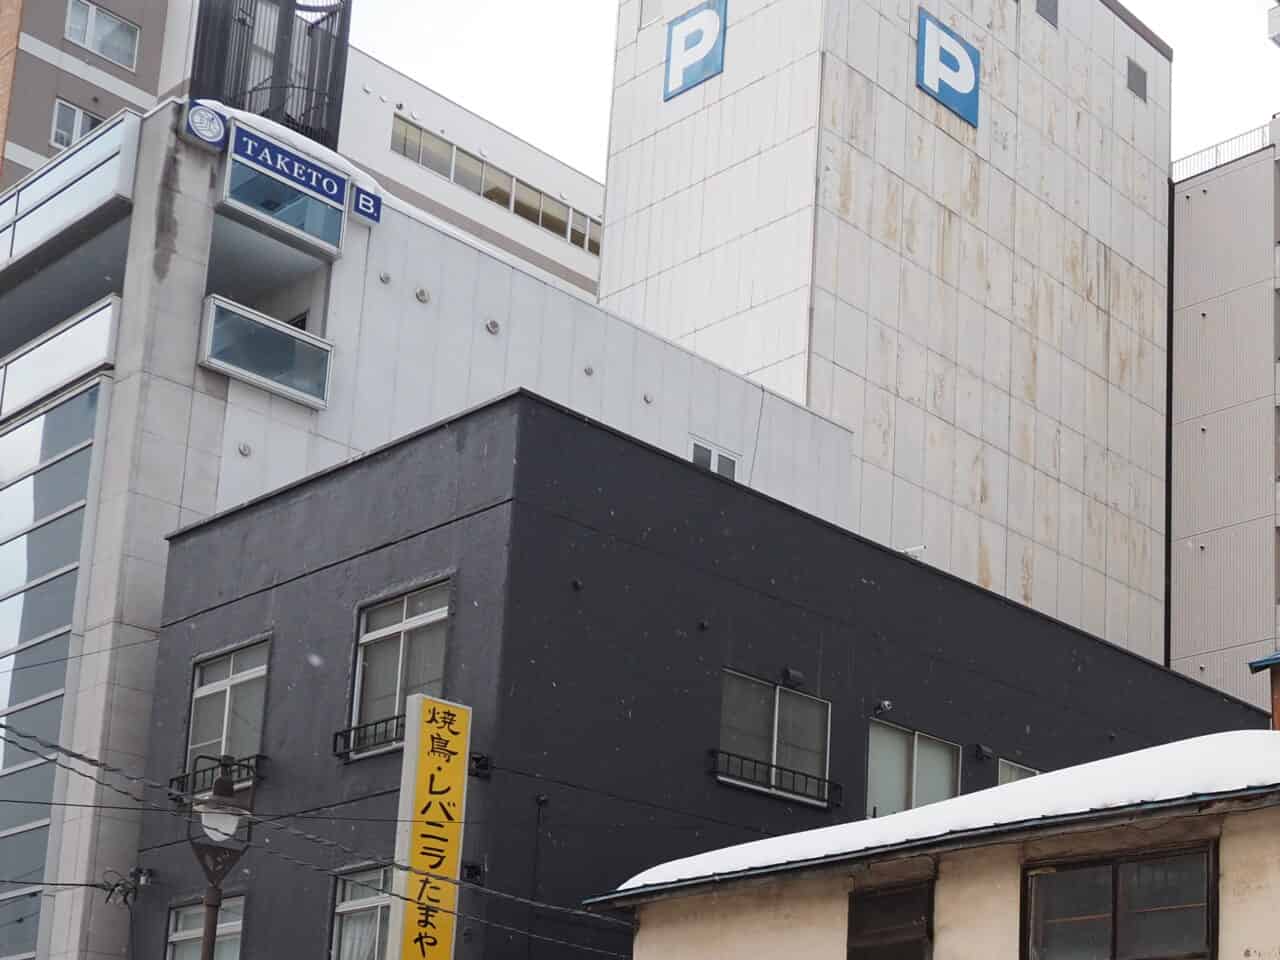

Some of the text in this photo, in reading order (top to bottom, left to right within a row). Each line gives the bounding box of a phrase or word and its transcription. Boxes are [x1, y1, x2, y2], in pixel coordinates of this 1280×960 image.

[667, 8, 720, 93] P
[923, 17, 976, 94] P
[242, 137, 338, 195] TAKETO
